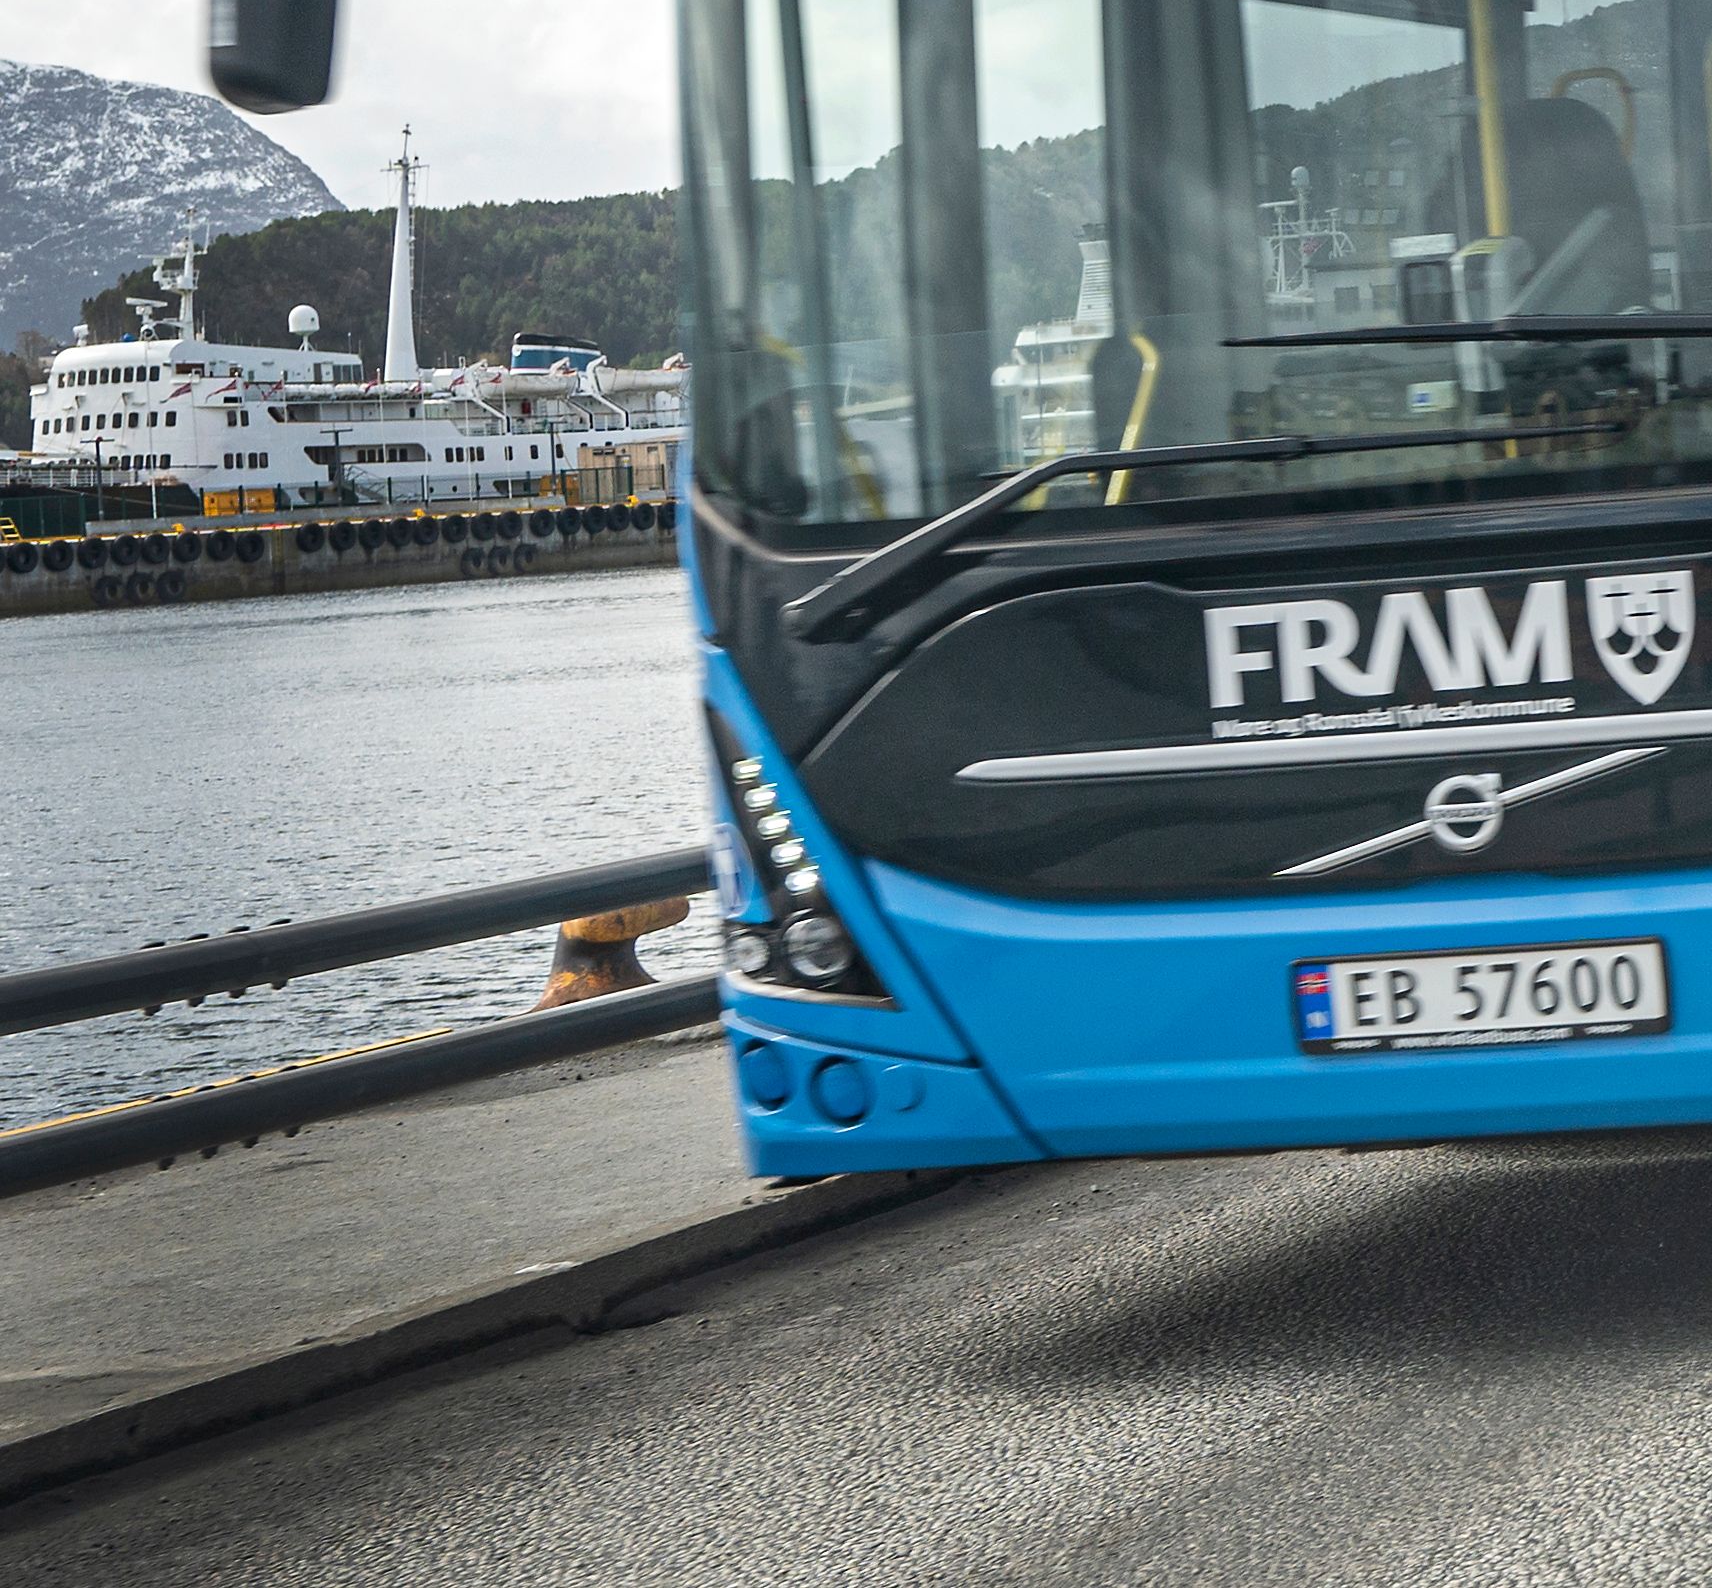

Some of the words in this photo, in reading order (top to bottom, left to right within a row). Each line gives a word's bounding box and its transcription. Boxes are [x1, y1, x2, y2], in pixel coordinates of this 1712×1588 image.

[1203, 579, 1574, 709] FRAM
[1345, 968, 1421, 1028] EB
[1452, 953, 1640, 1022] 57600
